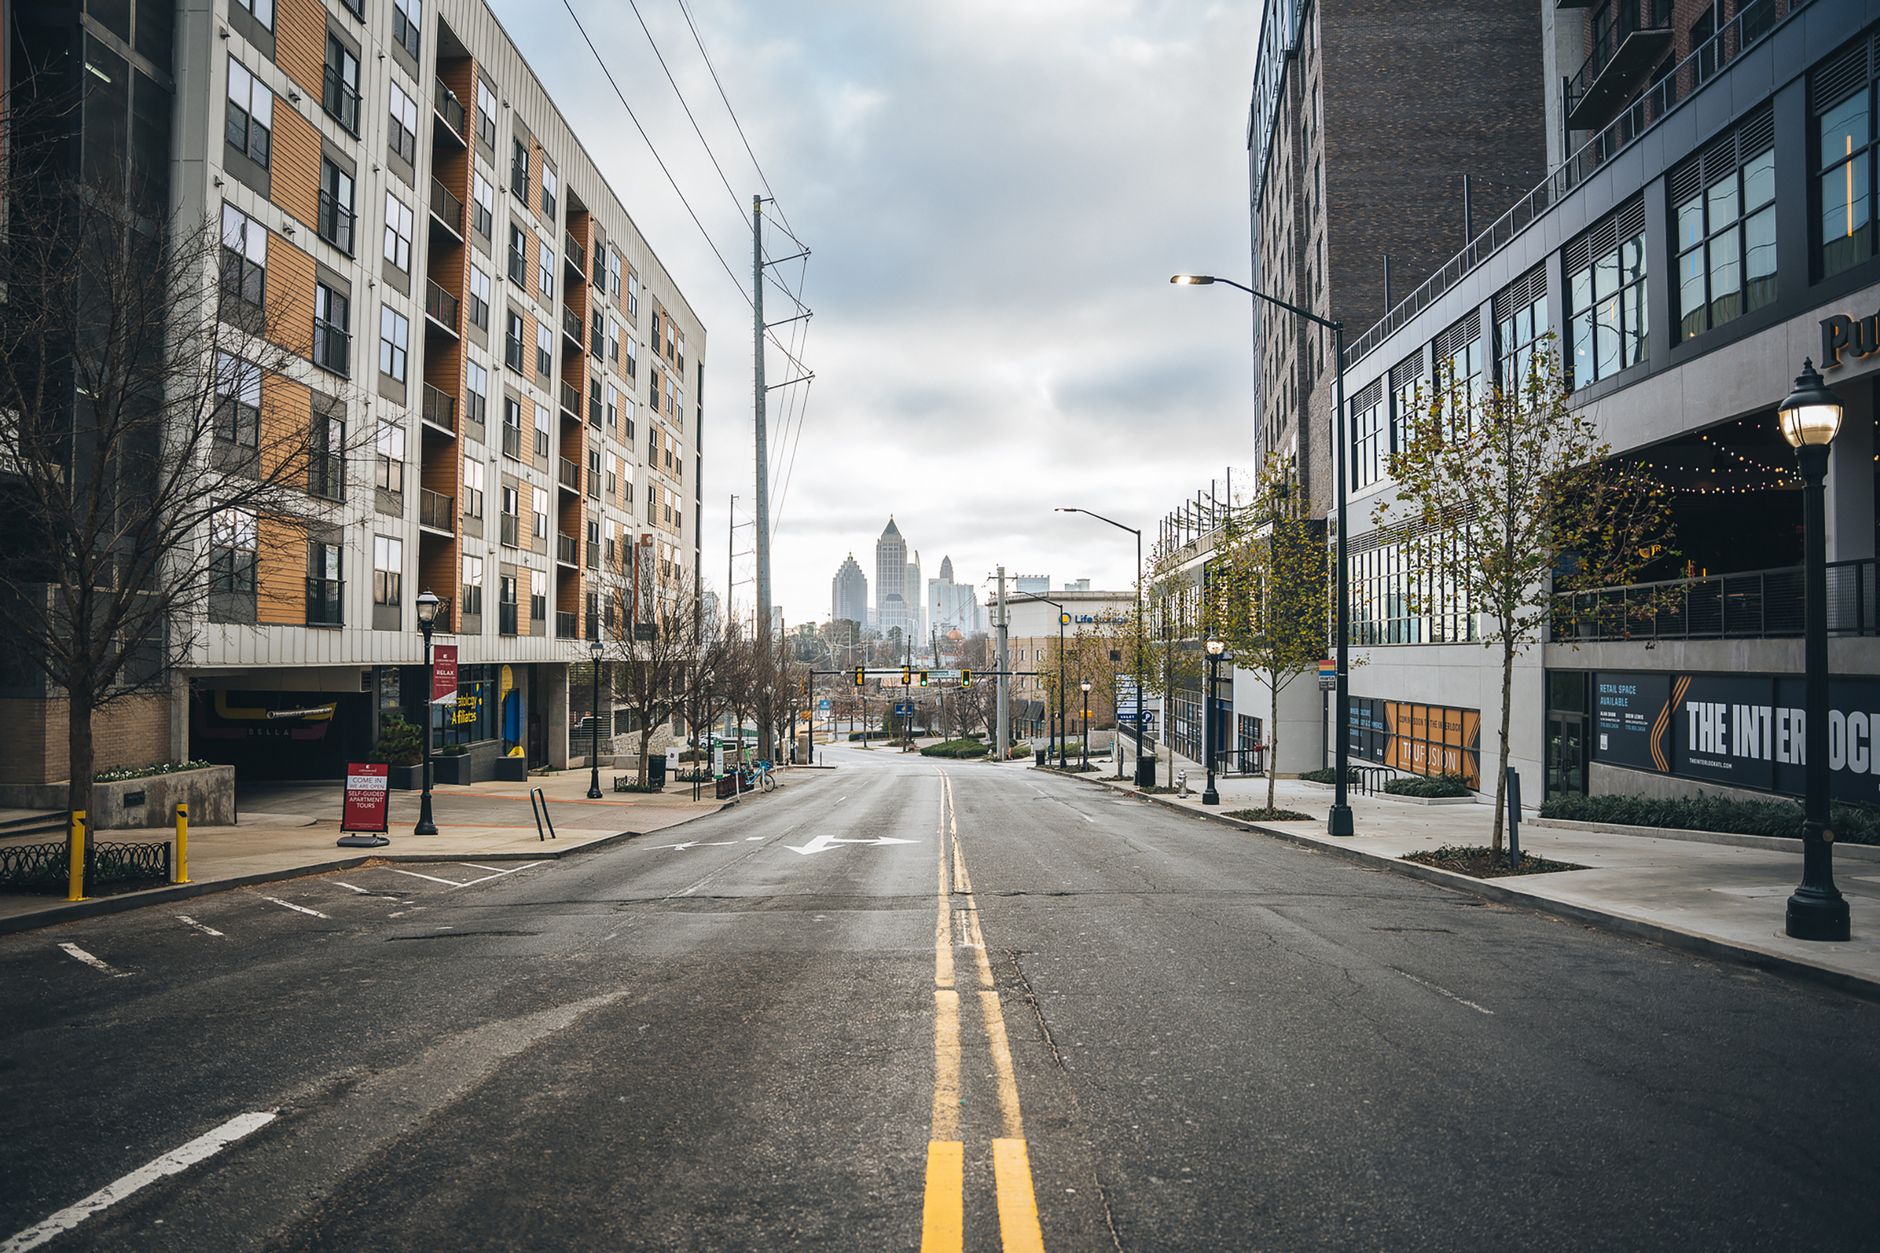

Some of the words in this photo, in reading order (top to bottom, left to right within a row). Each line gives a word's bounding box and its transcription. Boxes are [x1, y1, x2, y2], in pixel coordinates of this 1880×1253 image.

[1818, 309, 1880, 369] Pu
[1600, 684, 1617, 693] RETAIL
[1618, 685, 1636, 694] SPACE
[1600, 697, 1628, 707] AVAILABLE
[1686, 702, 1726, 755] THE
[1732, 704, 1880, 775] INTEROC
